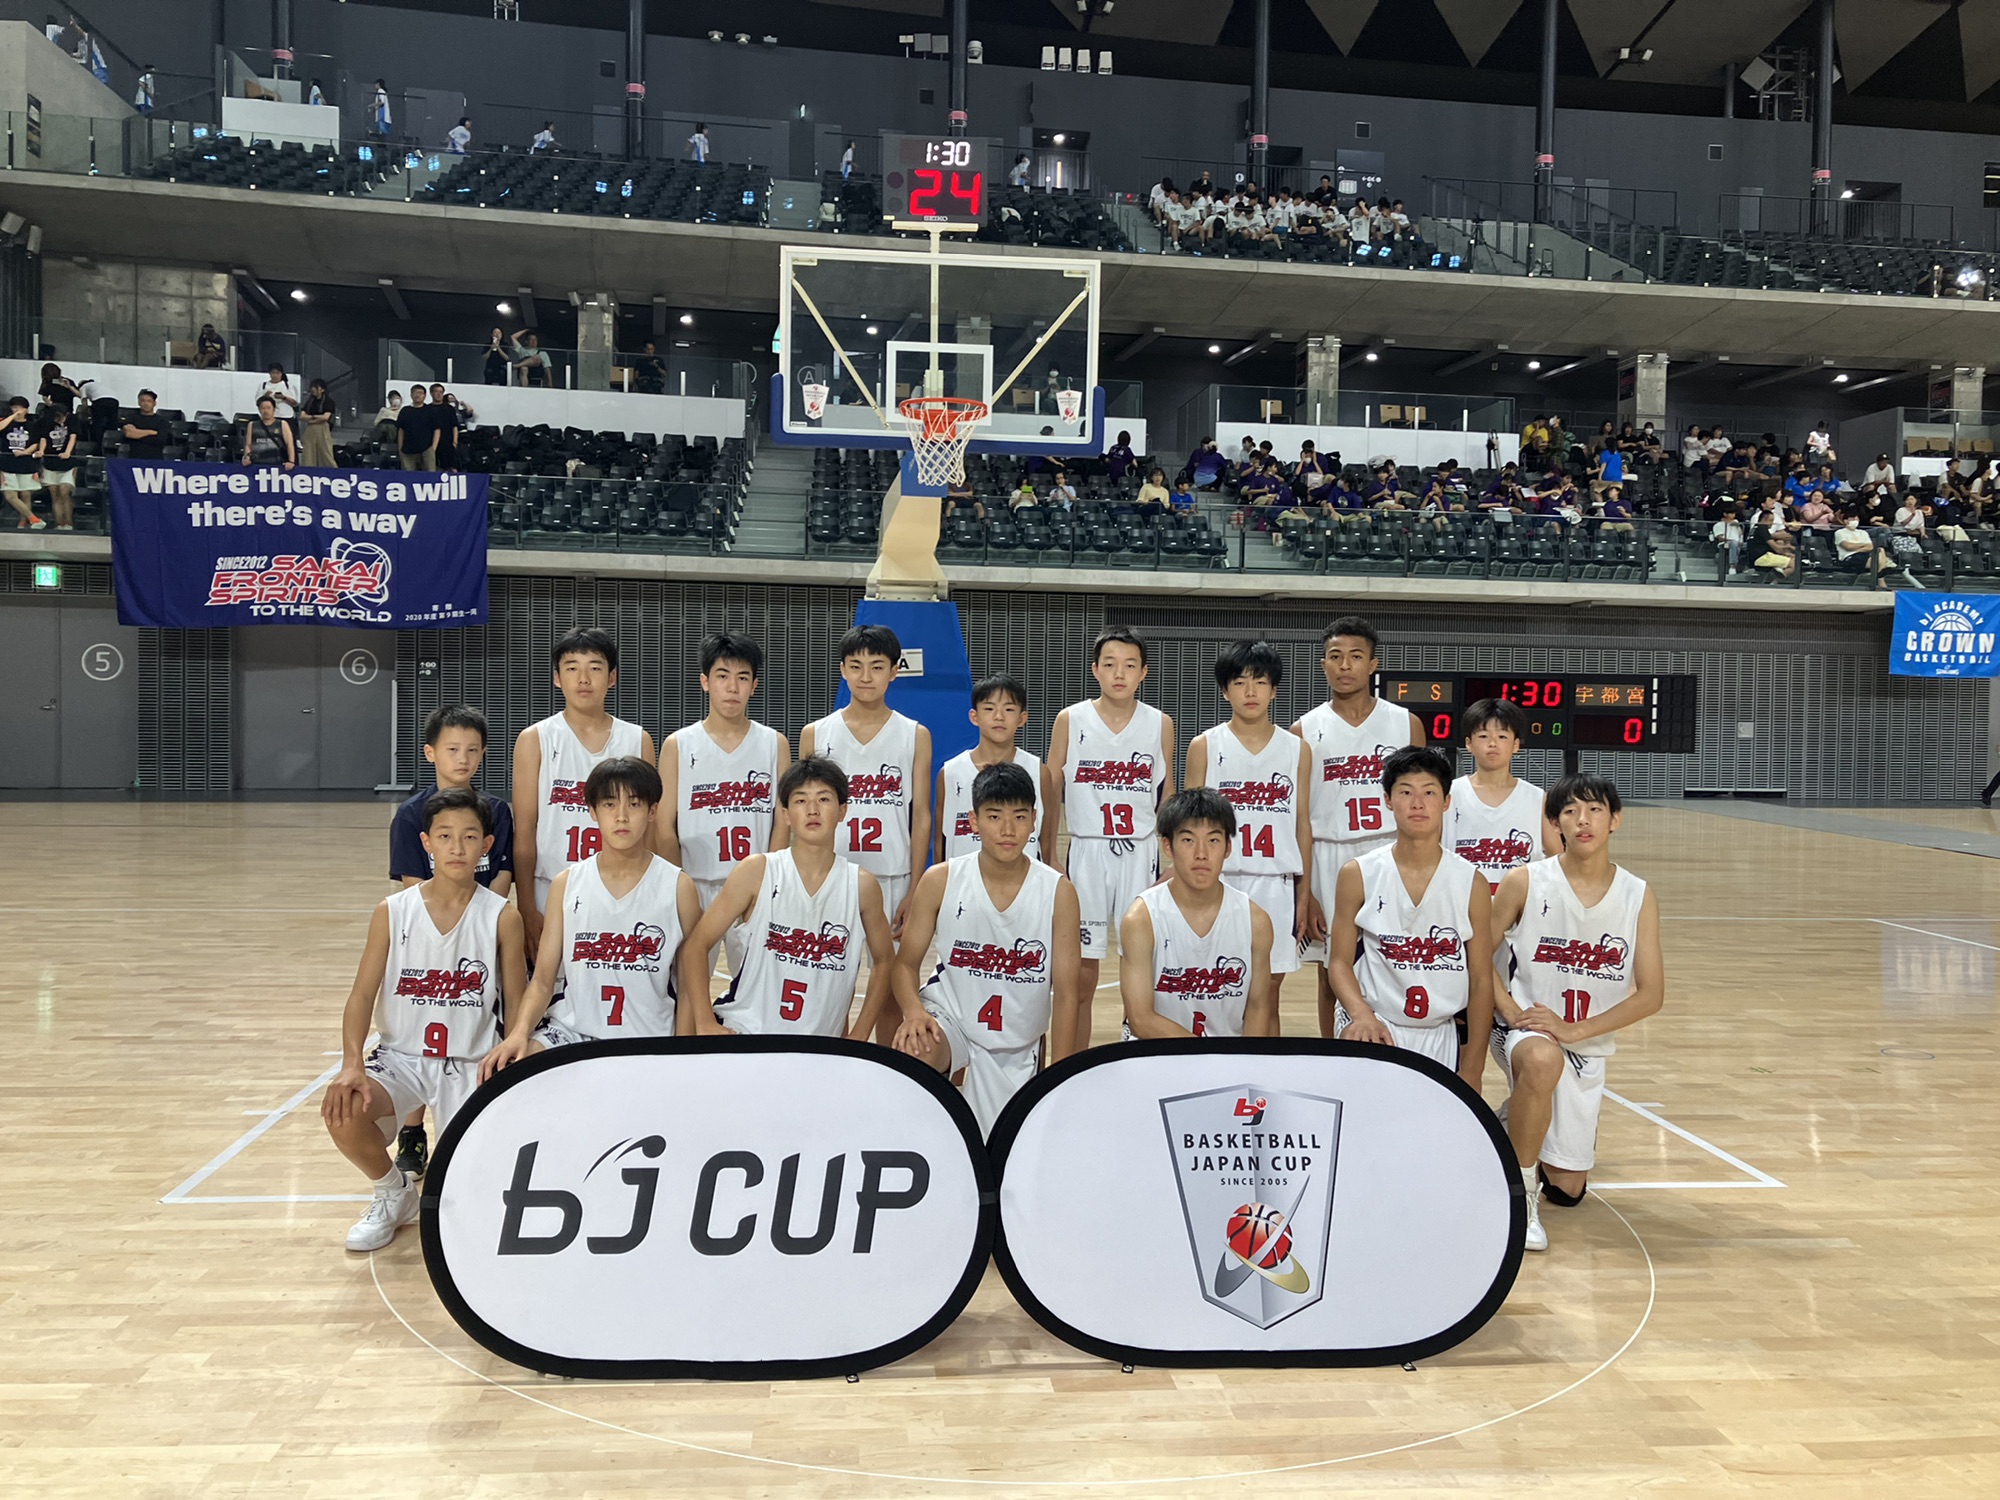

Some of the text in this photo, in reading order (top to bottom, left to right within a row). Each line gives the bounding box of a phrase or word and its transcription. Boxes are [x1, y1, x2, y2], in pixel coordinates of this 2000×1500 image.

[926, 141, 971, 166] 1:30
[909, 169, 982, 215] 24
[132, 467, 467, 502] Where there's a will
[187, 500, 417, 538] there's a way
[271, 554, 382, 578] SAKAI
[211, 571, 380, 594] FRONTIER
[204, 587, 340, 606] SPIRITS
[249, 605, 392, 622] TO THE WORLD
[1906, 630, 1995, 653] CROWN
[95, 651, 111, 672] 5
[351, 656, 367, 676] 6
[1501, 681, 1562, 707] 1:30
[1576, 684, 1645, 705] 宇都宮
[1433, 714, 1451, 739] 0
[1552, 722, 1562, 735] 0
[1624, 718, 1642, 743] 0
[1100, 803, 1134, 836] 13
[1345, 798, 1382, 831] 15
[566, 826, 602, 862] 18
[716, 826, 751, 862] 16
[847, 818, 882, 852] 12
[1239, 824, 1274, 858] 14
[586, 962, 600, 970] TO
[603, 962, 620, 970] THE
[775, 953, 846, 972] TO THE WORLD
[1392, 962, 1407, 970] TO
[1556, 965, 1569, 973] TO
[1587, 970, 1624, 981] WORLD
[968, 969, 1046, 984] TO THE WORLD
[601, 986, 625, 1026] 7
[779, 978, 808, 1022] 5
[1208, 990, 1243, 1000] WORLD
[1404, 986, 1430, 1020] 8
[978, 994, 1003, 1032] 4
[422, 1022, 448, 1059] 9
[1184, 1134, 1321, 1149] BASKETBALL
[1191, 1156, 1312, 1171] JAPAN CUP
[1220, 1178, 1288, 1186] SINCE 2005
[689, 1150, 931, 1256] CUP
